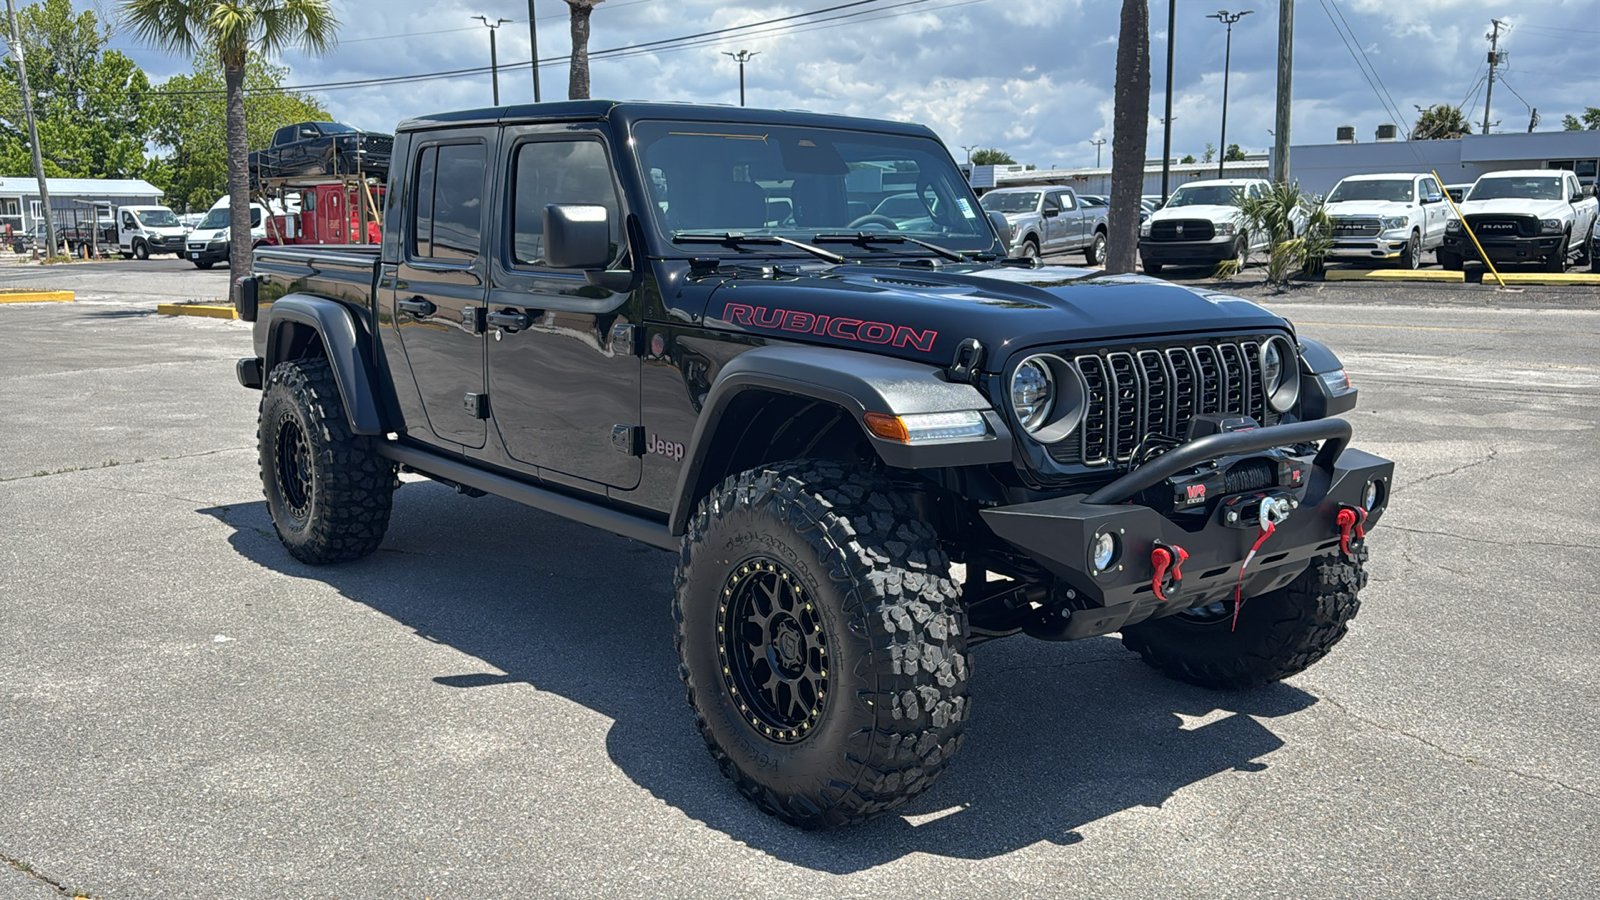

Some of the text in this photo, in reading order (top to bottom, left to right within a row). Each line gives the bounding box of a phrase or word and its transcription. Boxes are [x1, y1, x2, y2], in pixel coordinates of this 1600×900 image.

[722, 302, 938, 352] RUBICON
[646, 433, 685, 462] Jeep
[1186, 483, 1206, 498] VR
